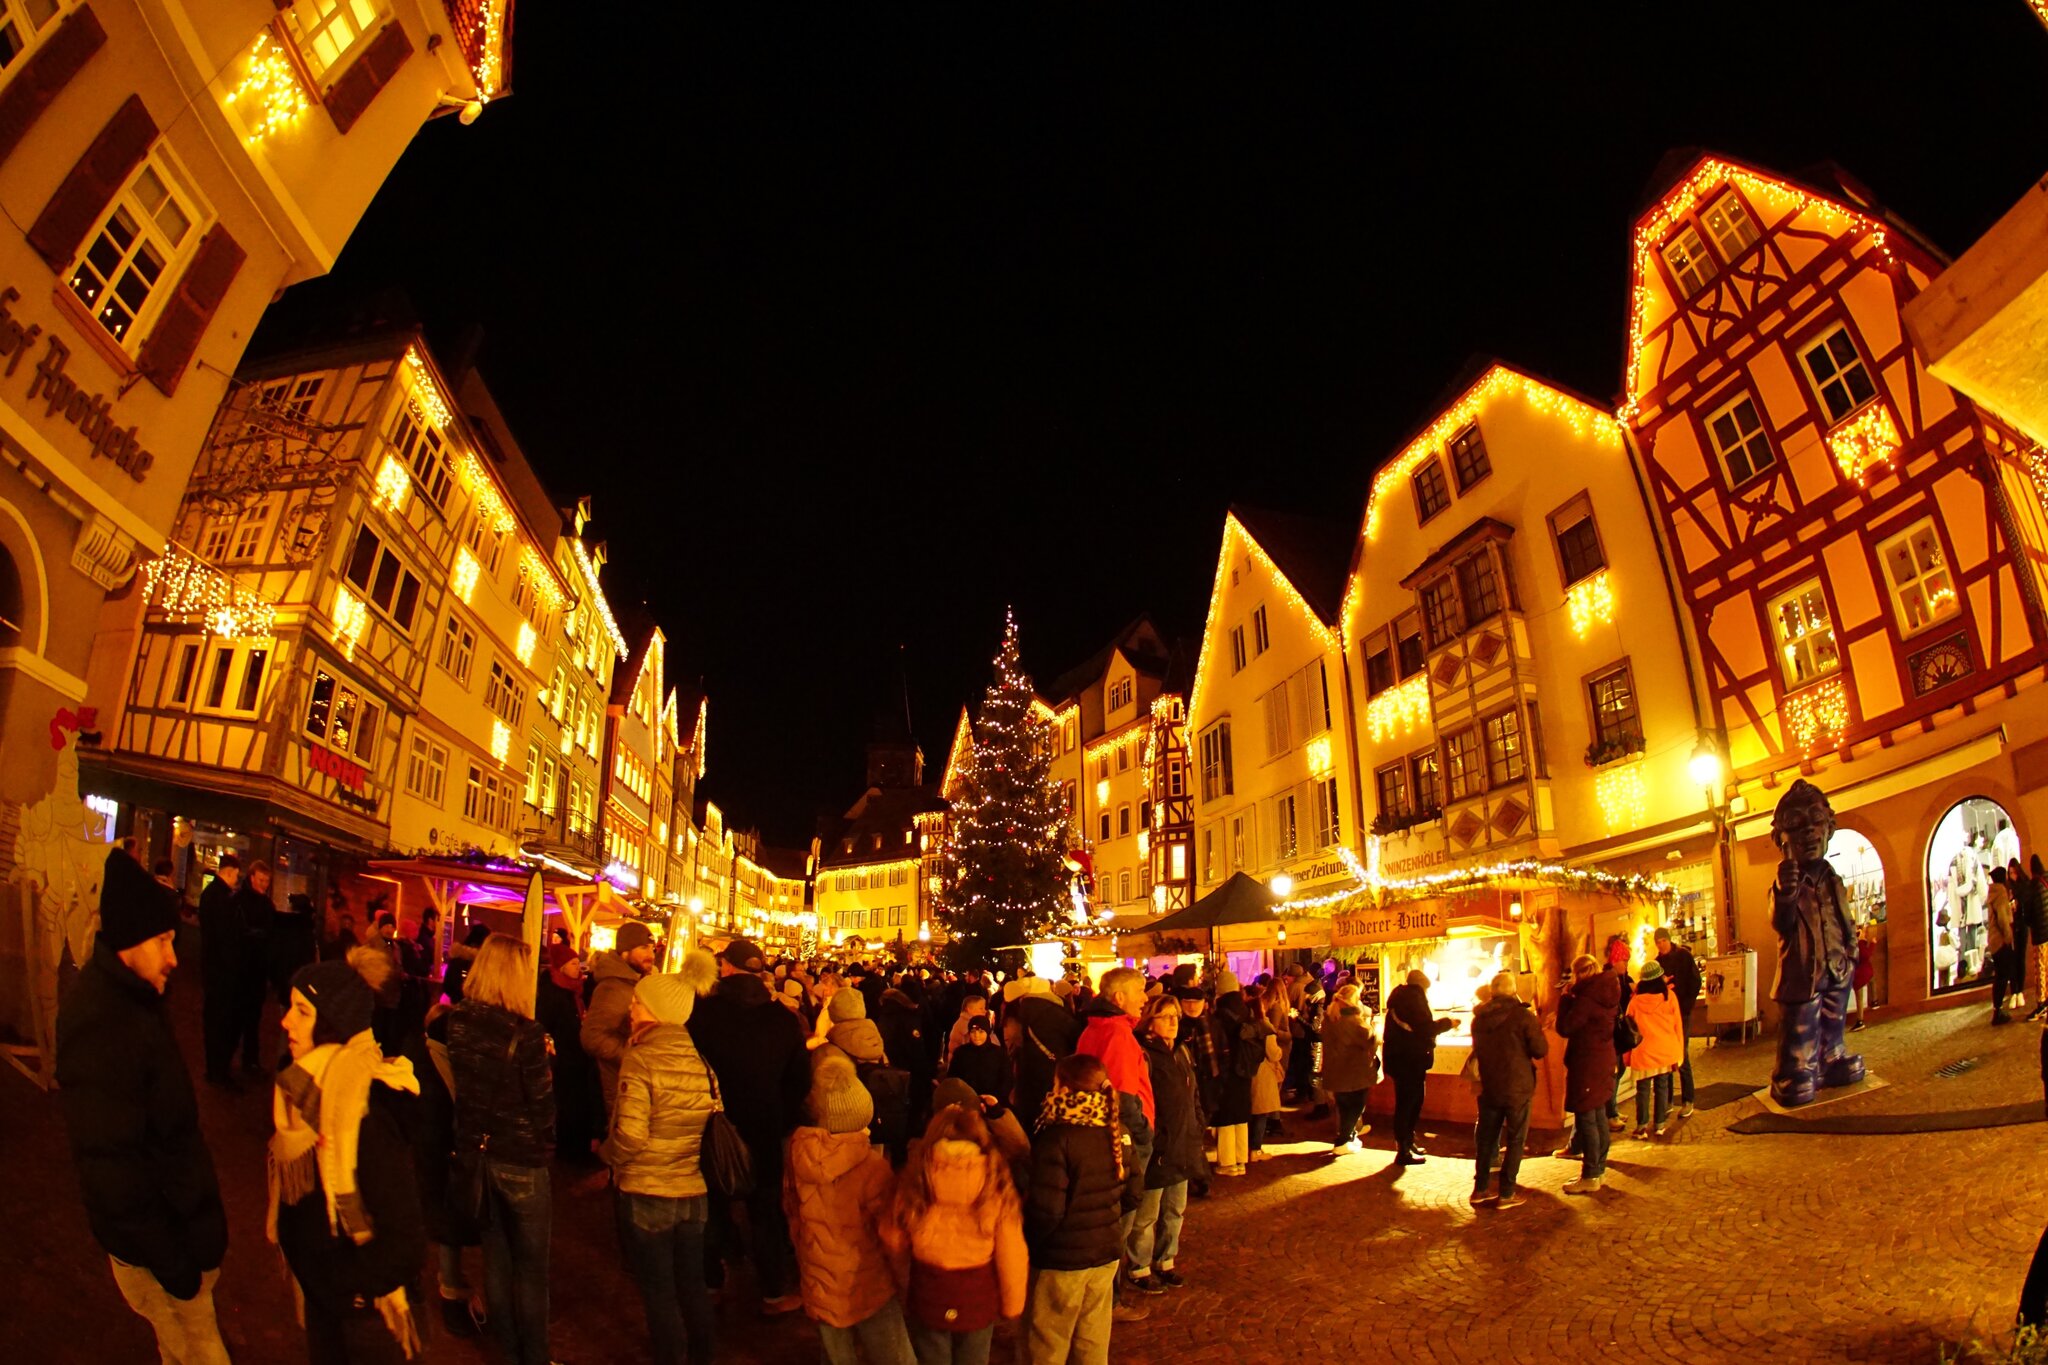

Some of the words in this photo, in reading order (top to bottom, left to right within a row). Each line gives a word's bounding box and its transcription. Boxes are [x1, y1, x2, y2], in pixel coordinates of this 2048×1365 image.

[27, 333, 155, 484] Apotheke
[1311, 860, 1349, 879] Zeitung
[1336, 911, 1437, 938] Wilderer-Hütte
